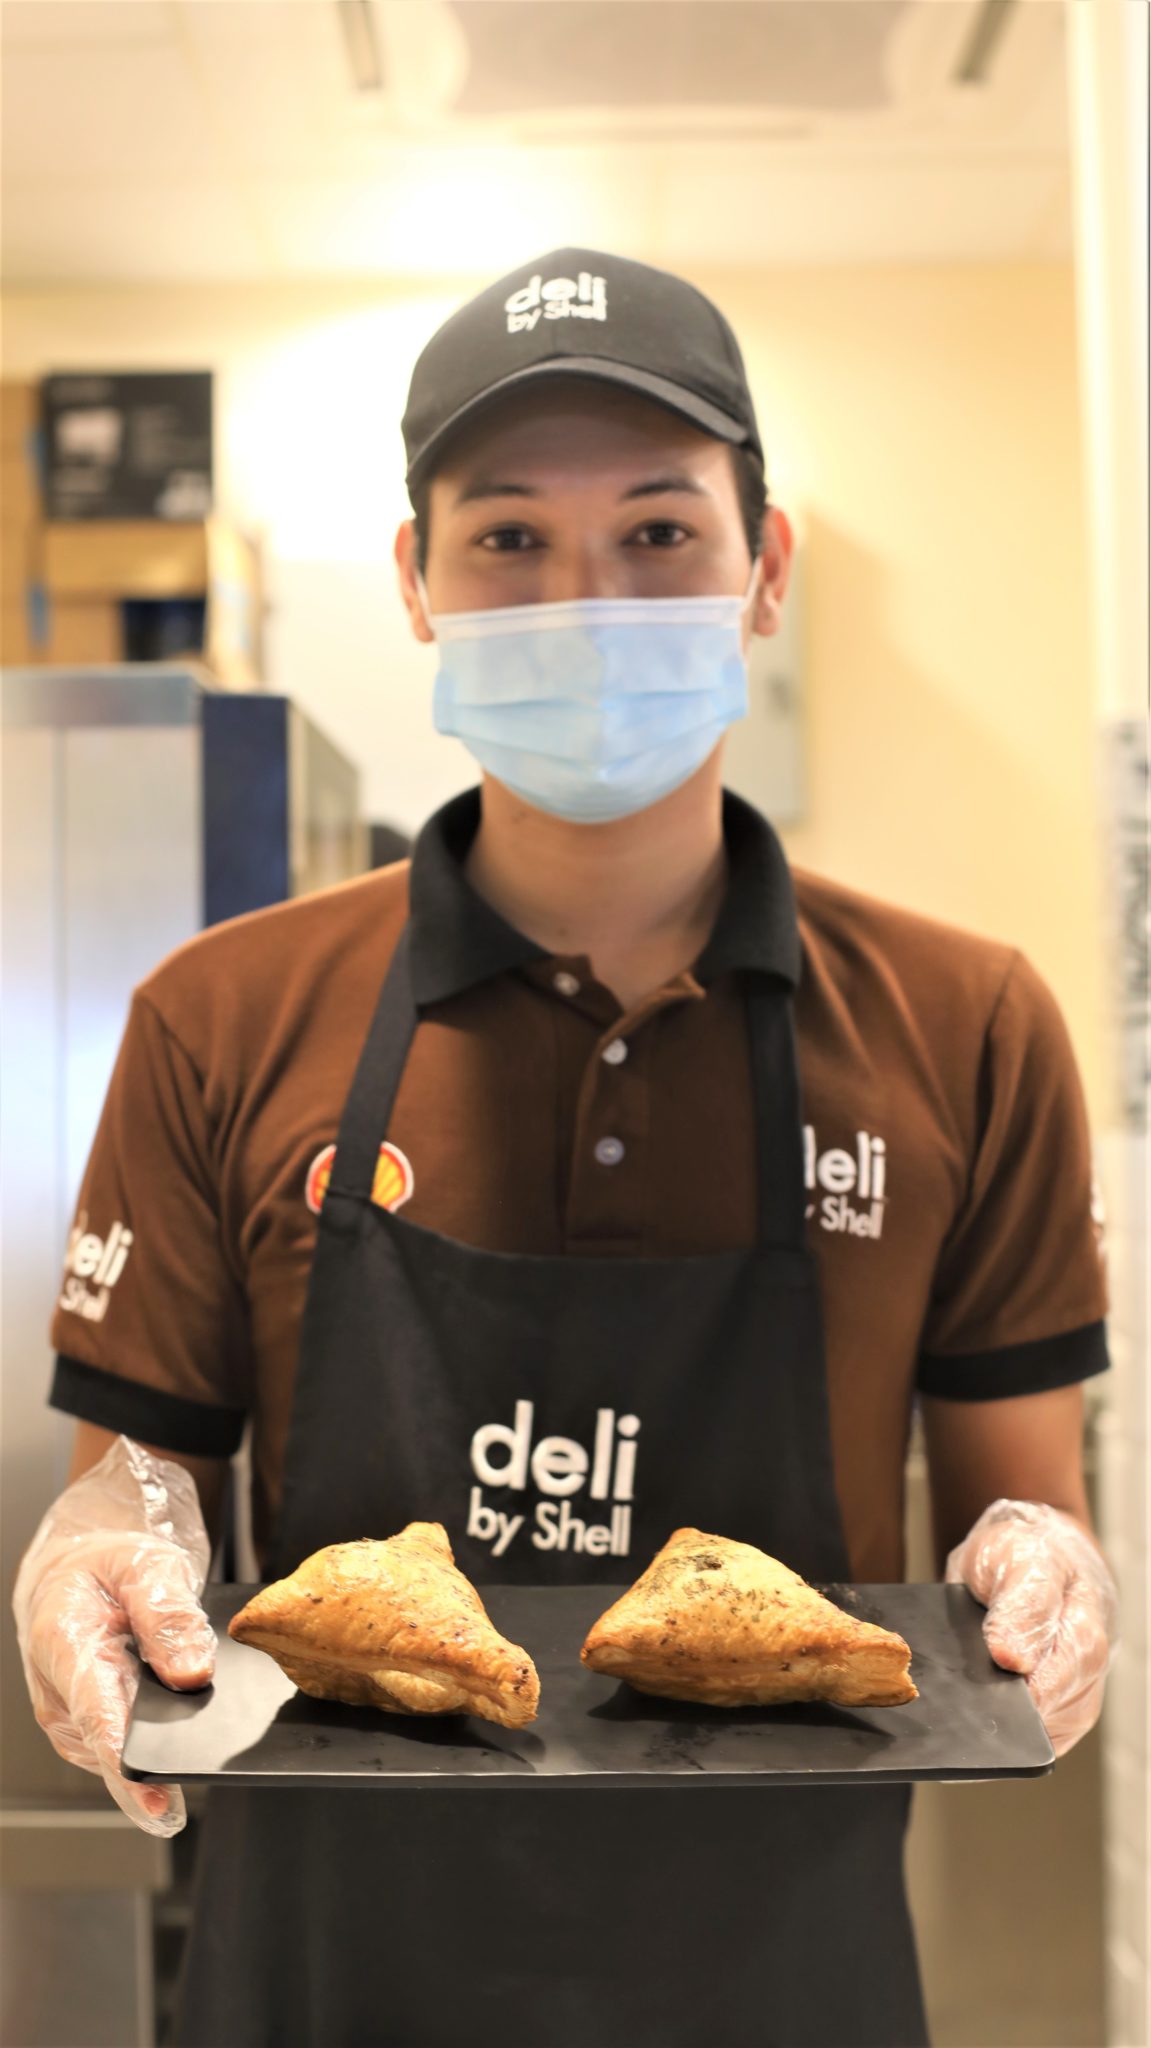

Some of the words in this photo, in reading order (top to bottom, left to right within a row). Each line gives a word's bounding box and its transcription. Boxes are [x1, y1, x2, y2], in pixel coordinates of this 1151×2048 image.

[505, 272, 607, 313] deli
[507, 307, 542, 333] by
[543, 299, 608, 321] Shell
[820, 1195, 885, 1239] Shell
[470, 1399, 641, 1500] deli
[466, 1486, 525, 1557] by
[531, 1500, 632, 1557] Shell
